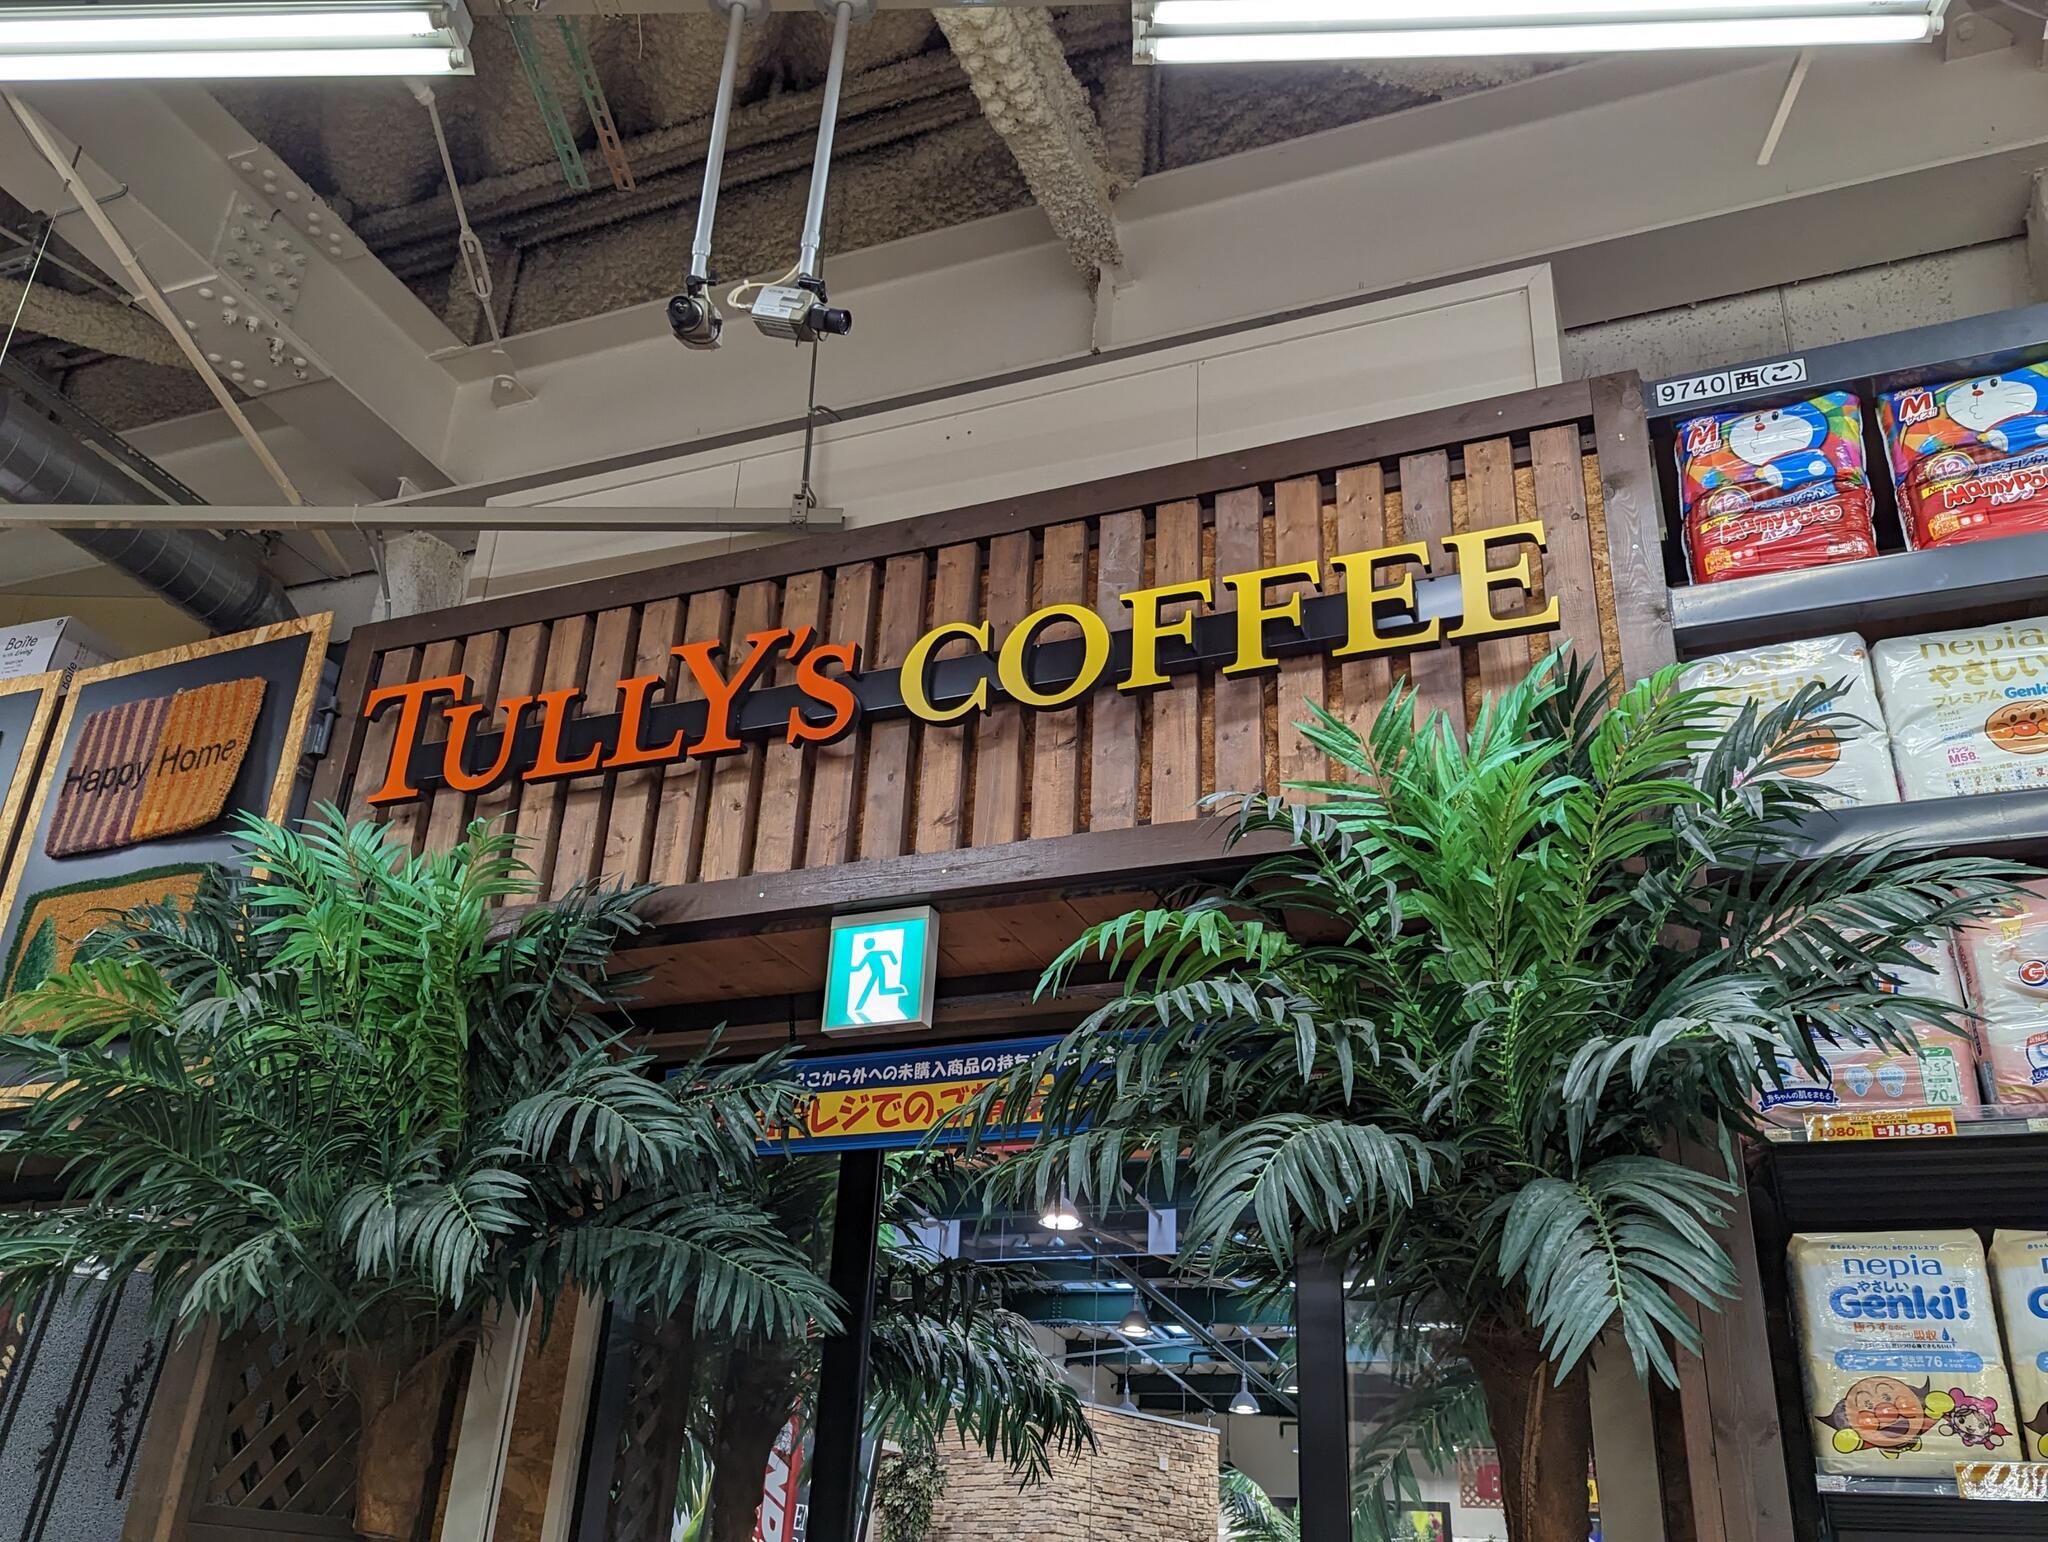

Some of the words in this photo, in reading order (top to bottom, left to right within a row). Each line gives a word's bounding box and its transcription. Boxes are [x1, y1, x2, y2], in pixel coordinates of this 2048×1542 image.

[1661, 376, 1726, 402] 9740
[899, 519, 1561, 723] COFFEE
[61, 758, 152, 798] Happy
[157, 738, 237, 778] Home
[1842, 1254, 1943, 1280] nepia
[1829, 1285, 1971, 1321] Genki!
[1857, 1281, 1909, 1294] やさしい
